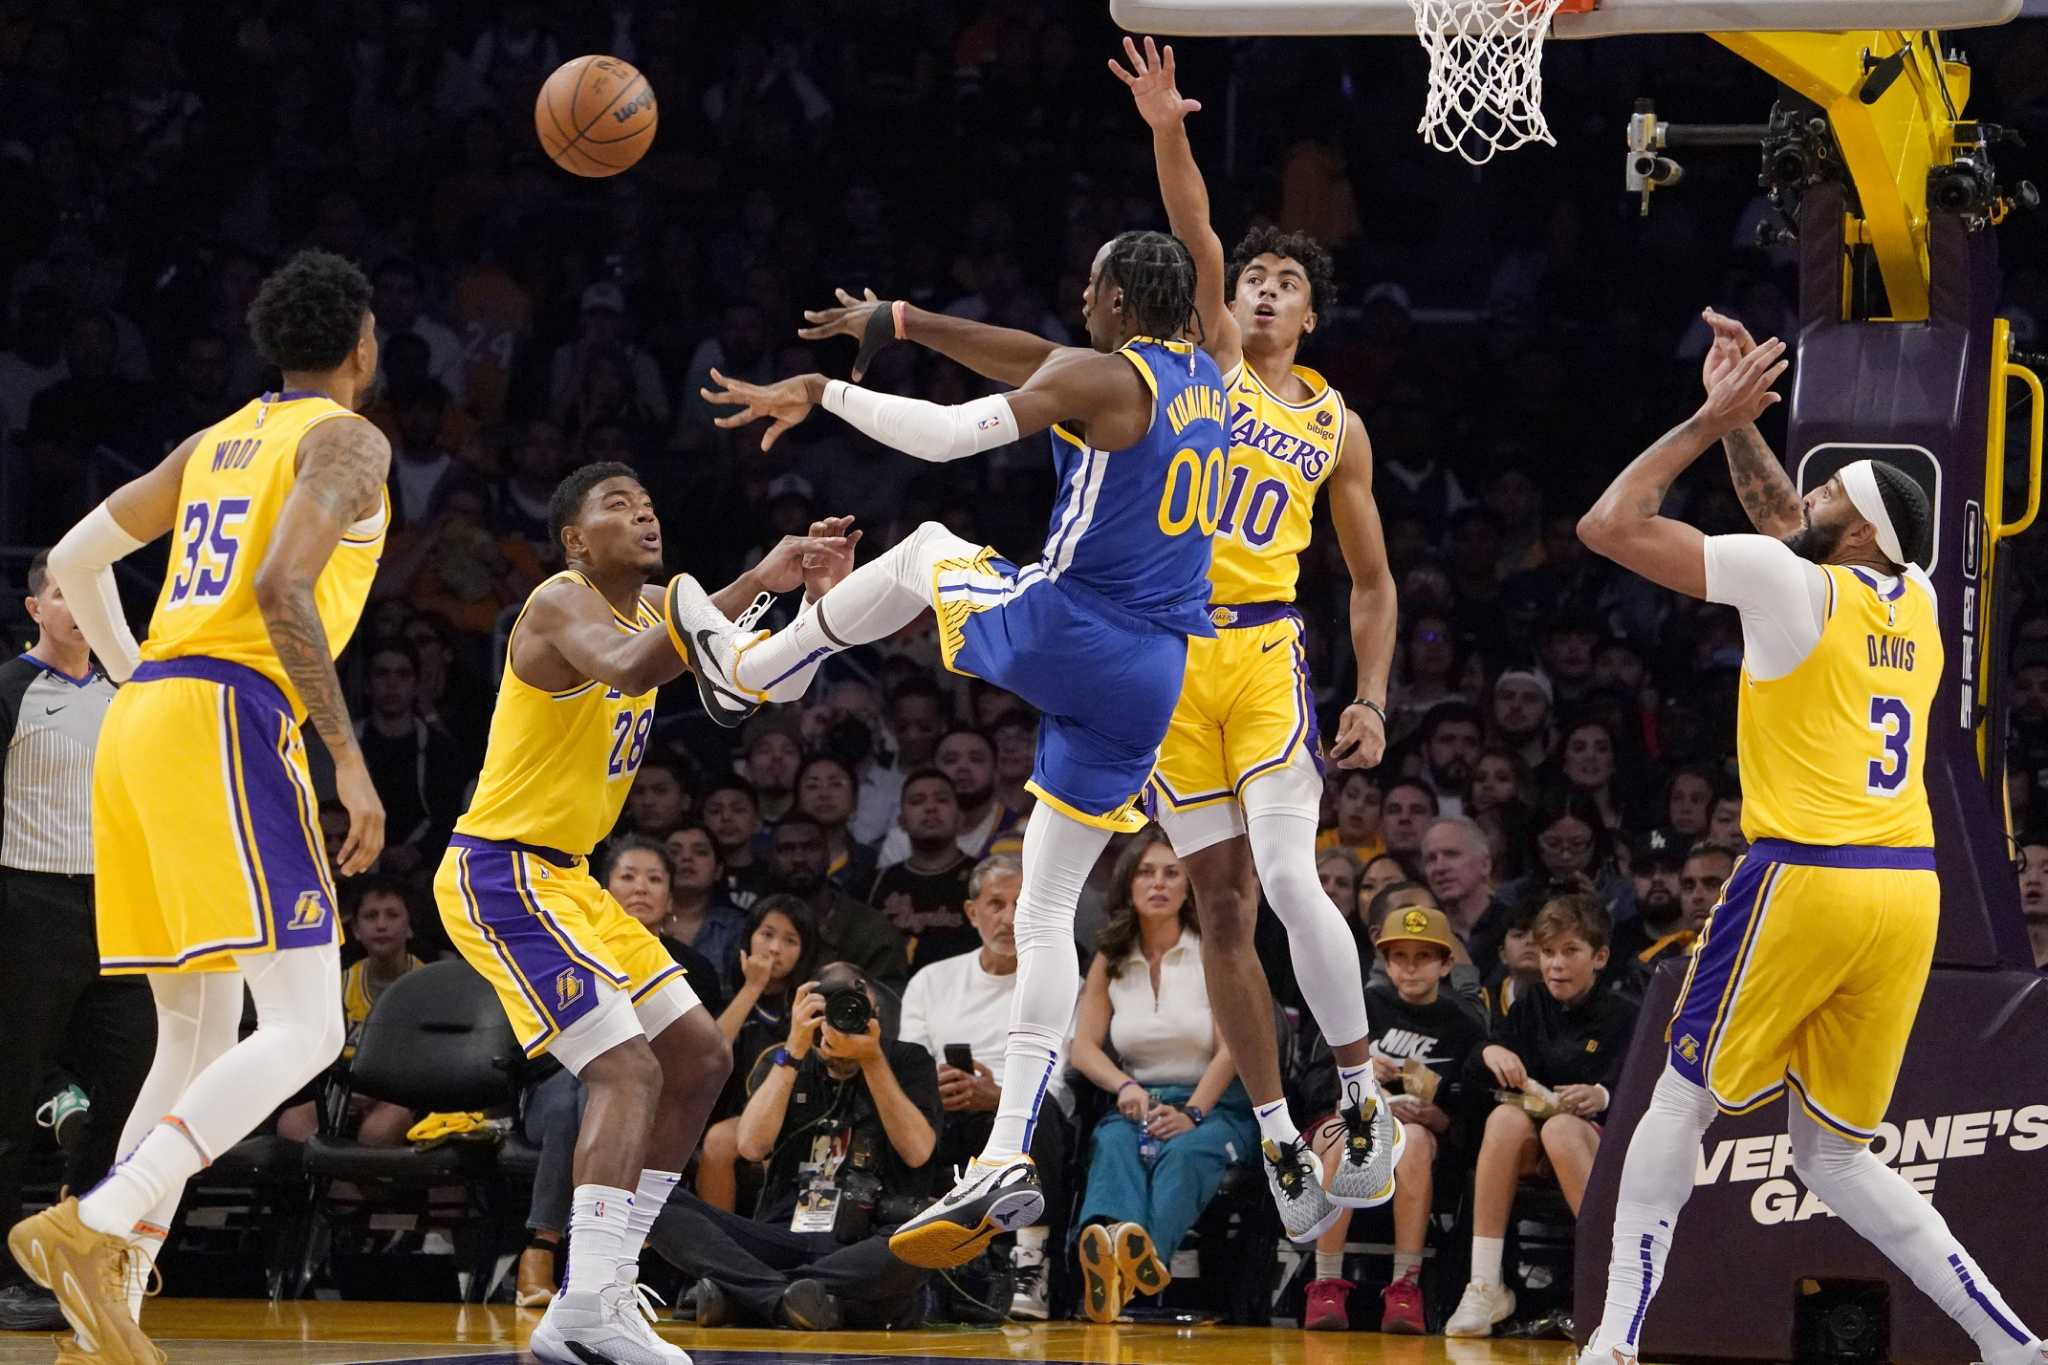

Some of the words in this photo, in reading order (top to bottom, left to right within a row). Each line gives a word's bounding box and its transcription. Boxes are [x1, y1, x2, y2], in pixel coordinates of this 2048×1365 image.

[211, 438, 262, 473] WOOD
[1230, 402, 1329, 482] LAKERS
[1306, 422, 1335, 441] bibigo
[1158, 447, 1225, 536] 00
[1215, 465, 1290, 552] 10
[165, 497, 252, 611] 35
[1866, 634, 1916, 672] DAVIS
[607, 706, 655, 781] 28
[1867, 694, 1913, 797] 3
[1379, 1027, 1440, 1058] NIKE
[1694, 1104, 2048, 1186] VEONE'S
[1750, 1162, 1939, 1225] GAE
